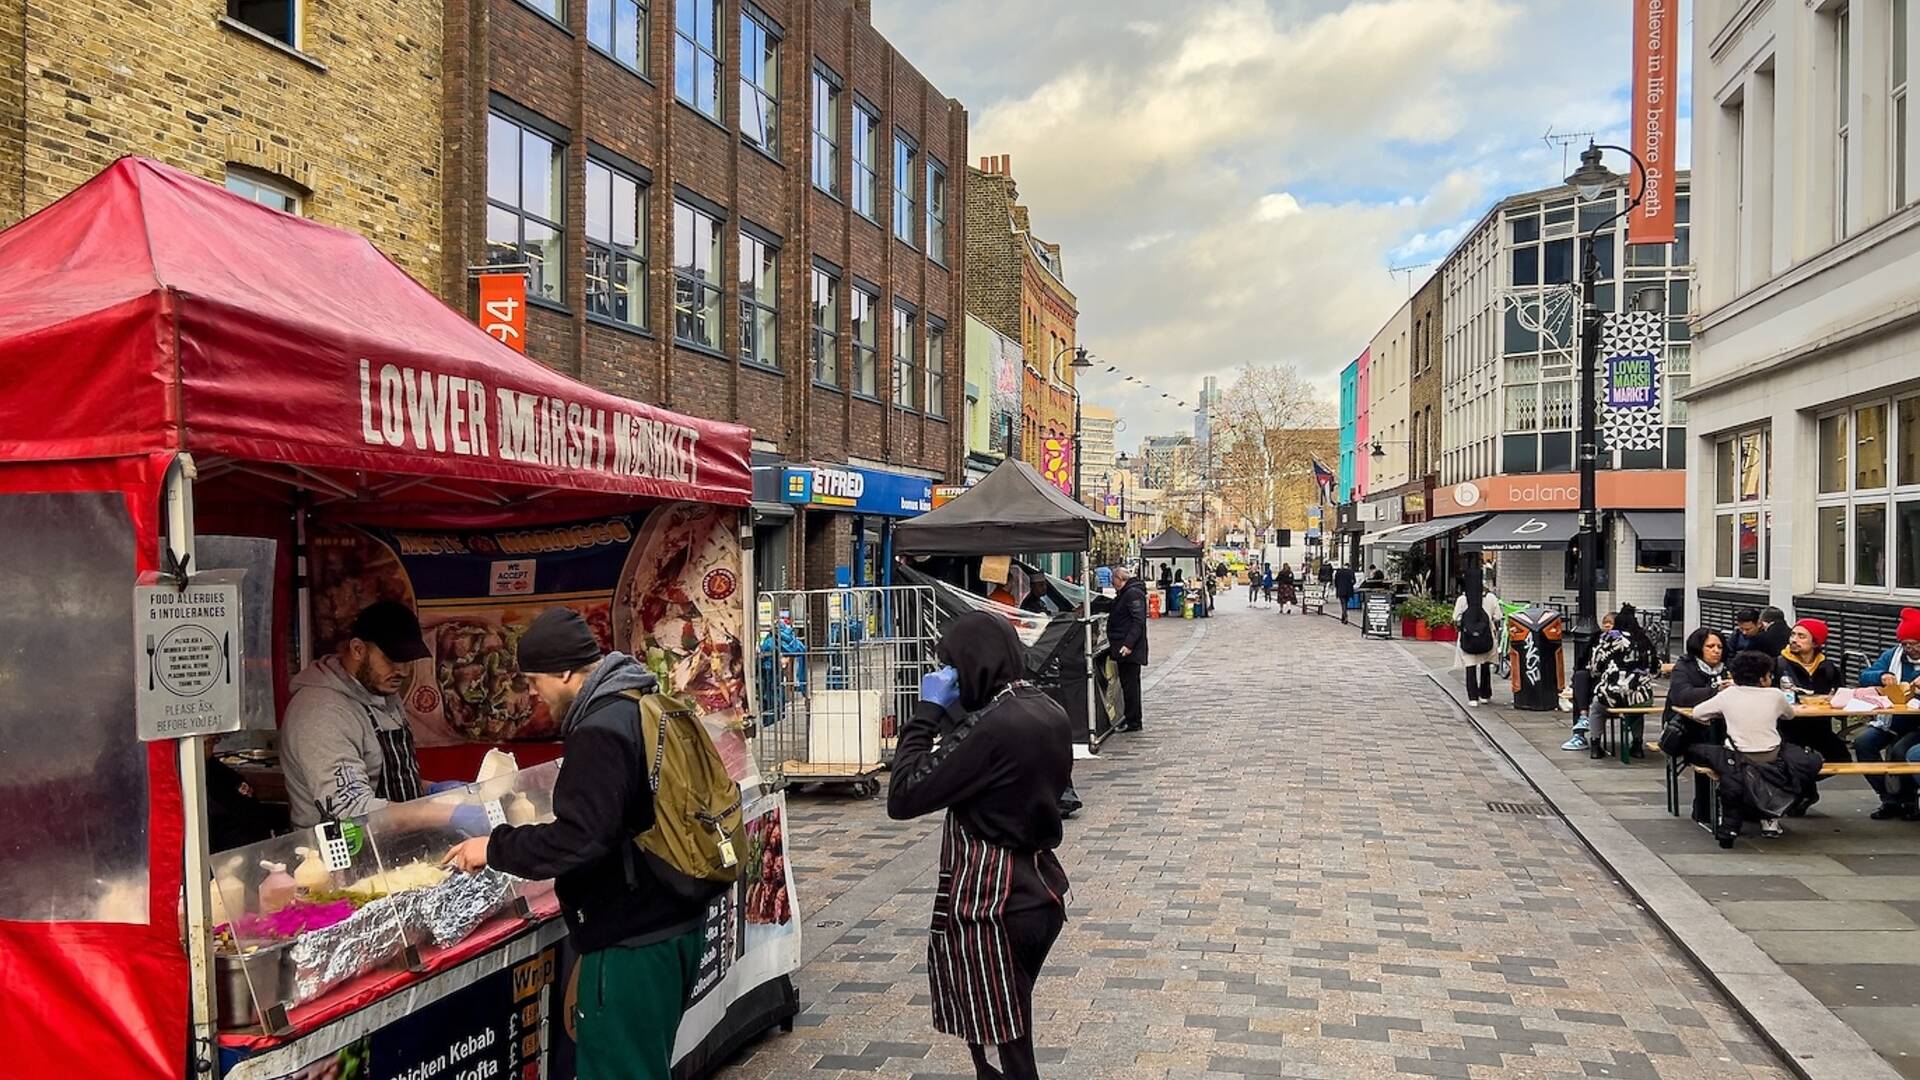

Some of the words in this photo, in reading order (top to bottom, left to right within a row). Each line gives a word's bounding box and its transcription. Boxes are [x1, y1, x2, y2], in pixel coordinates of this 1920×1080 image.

[1648, 0, 1665, 50] elieve
[1647, 55, 1665, 73] in
[1647, 77, 1665, 104] life
[1646, 108, 1663, 163] before
[1645, 168, 1662, 218] death
[1613, 360, 1651, 375] LOWER
[1613, 374, 1651, 388] MARSH
[1613, 387, 1650, 403] MARKET
[360, 358, 490, 457] LOWER
[496, 387, 606, 472] MARSH
[613, 411, 700, 484] MARKET
[812, 468, 864, 498] ETFRED
[1509, 484, 1579, 502] balanc
[1512, 518, 1548, 534] b
[497, 571, 529, 580] ACCEPT
[150, 593, 175, 605] FOOD
[177, 592, 225, 605] ALLERGIES
[150, 608, 156, 619] &
[159, 606, 226, 619] INTOLERANCES
[165, 702, 196, 716] PLEASE
[199, 701, 215, 713] ASK
[157, 718, 188, 732] BEFORE
[207, 714, 222, 727] EAT
[514, 961, 552, 990] Wrp
[390, 1054, 446, 1080] icken
[450, 1027, 495, 1064] Kebab
